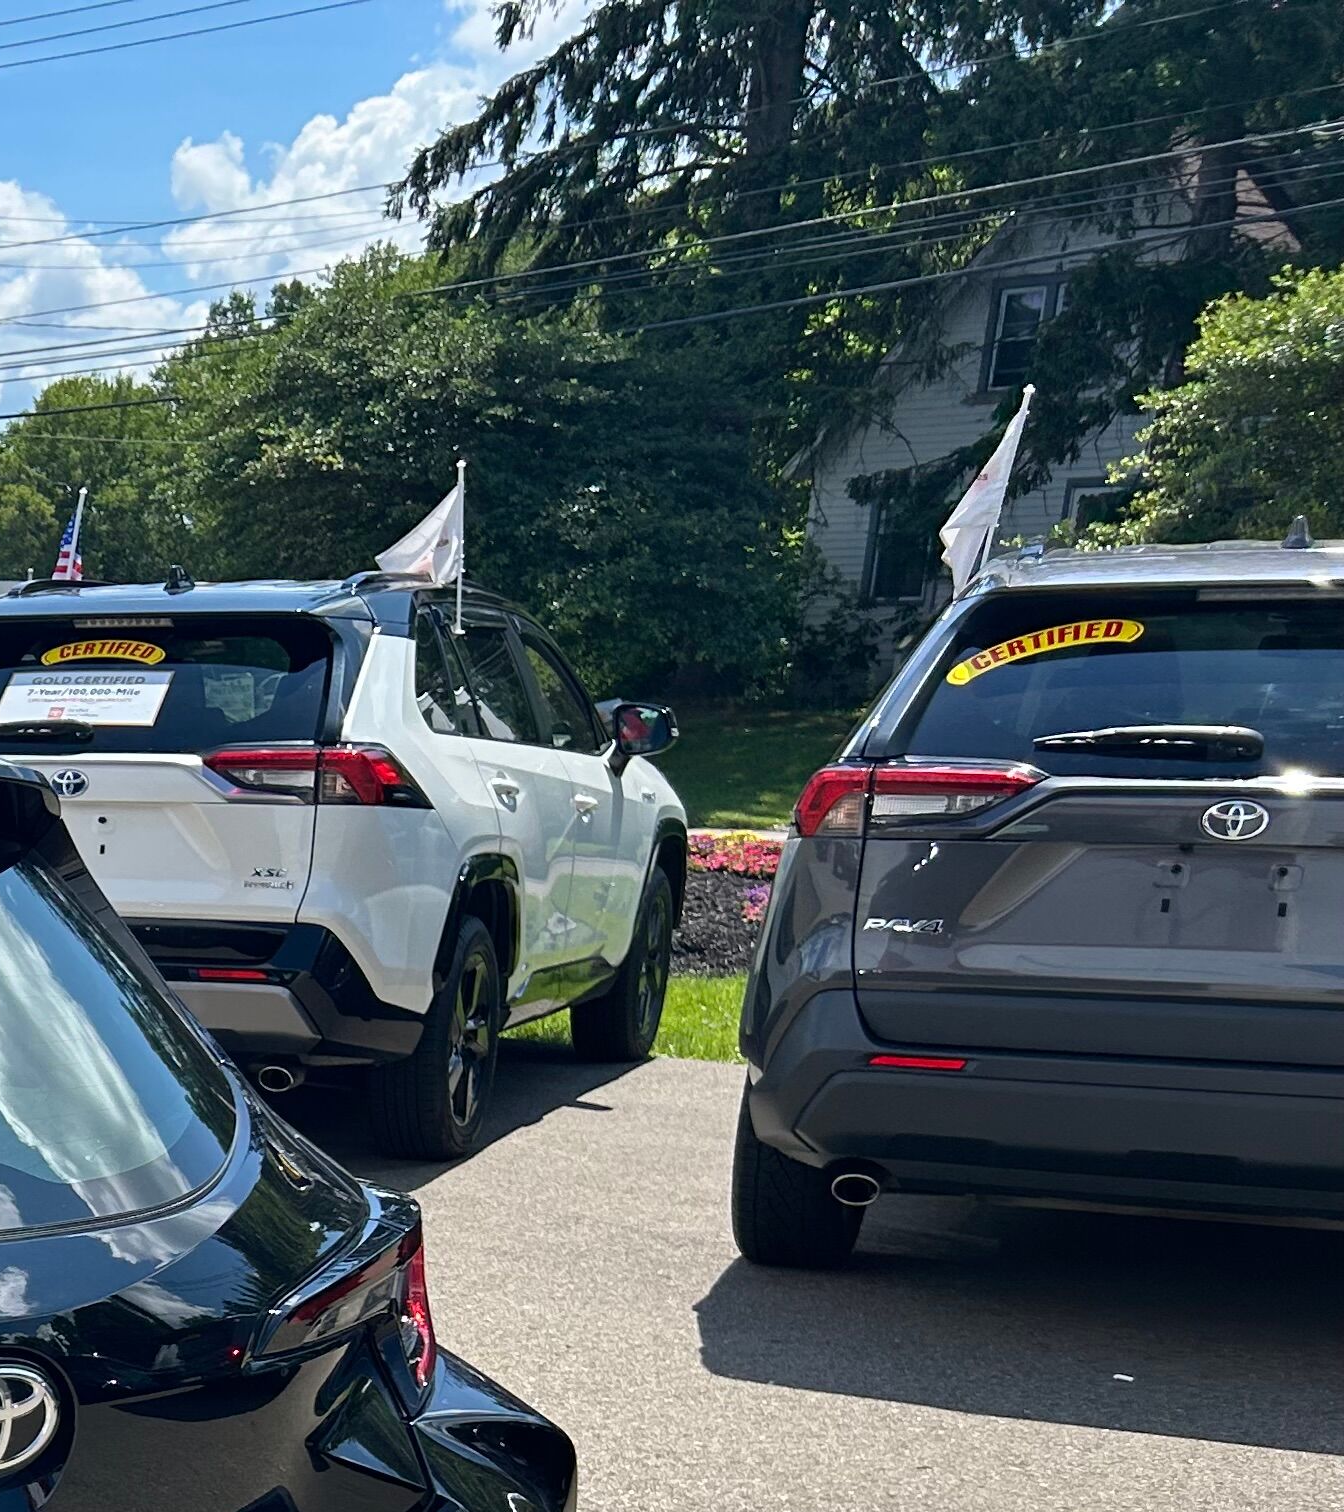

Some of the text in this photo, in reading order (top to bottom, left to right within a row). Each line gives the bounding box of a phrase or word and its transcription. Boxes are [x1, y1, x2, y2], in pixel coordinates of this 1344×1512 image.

[59, 642, 156, 659] CERTIFIED
[970, 621, 1124, 670] CERTIFIED
[33, 676, 146, 685] GOLD CERTIFIED
[862, 918, 944, 935] RAV4
